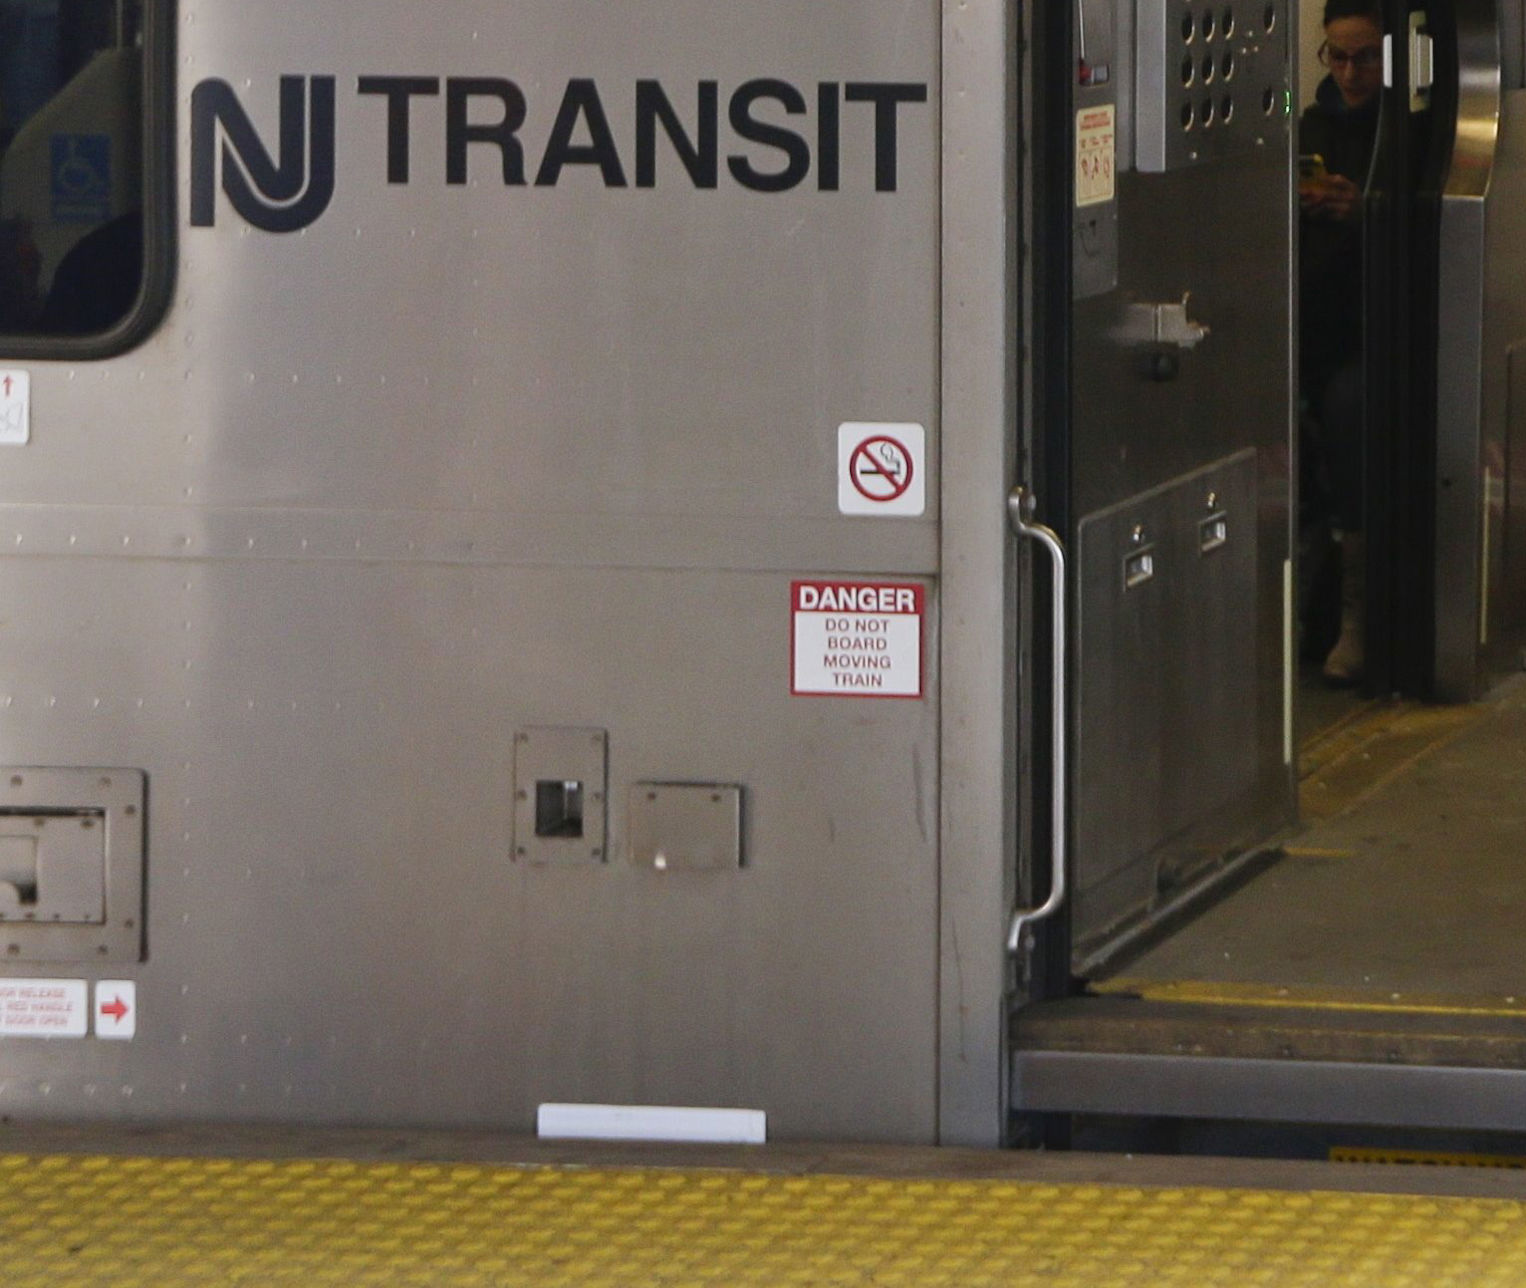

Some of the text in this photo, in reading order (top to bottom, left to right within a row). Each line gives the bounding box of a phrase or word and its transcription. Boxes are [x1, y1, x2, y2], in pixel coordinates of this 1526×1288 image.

[189, 74, 928, 233] NJ TRANSIT
[800, 585, 915, 612] DANGER
[825, 618, 890, 633] DO NOT
[828, 637, 887, 650] BOARD
[824, 654, 891, 669] MOVING
[833, 673, 882, 687] TRAIN
